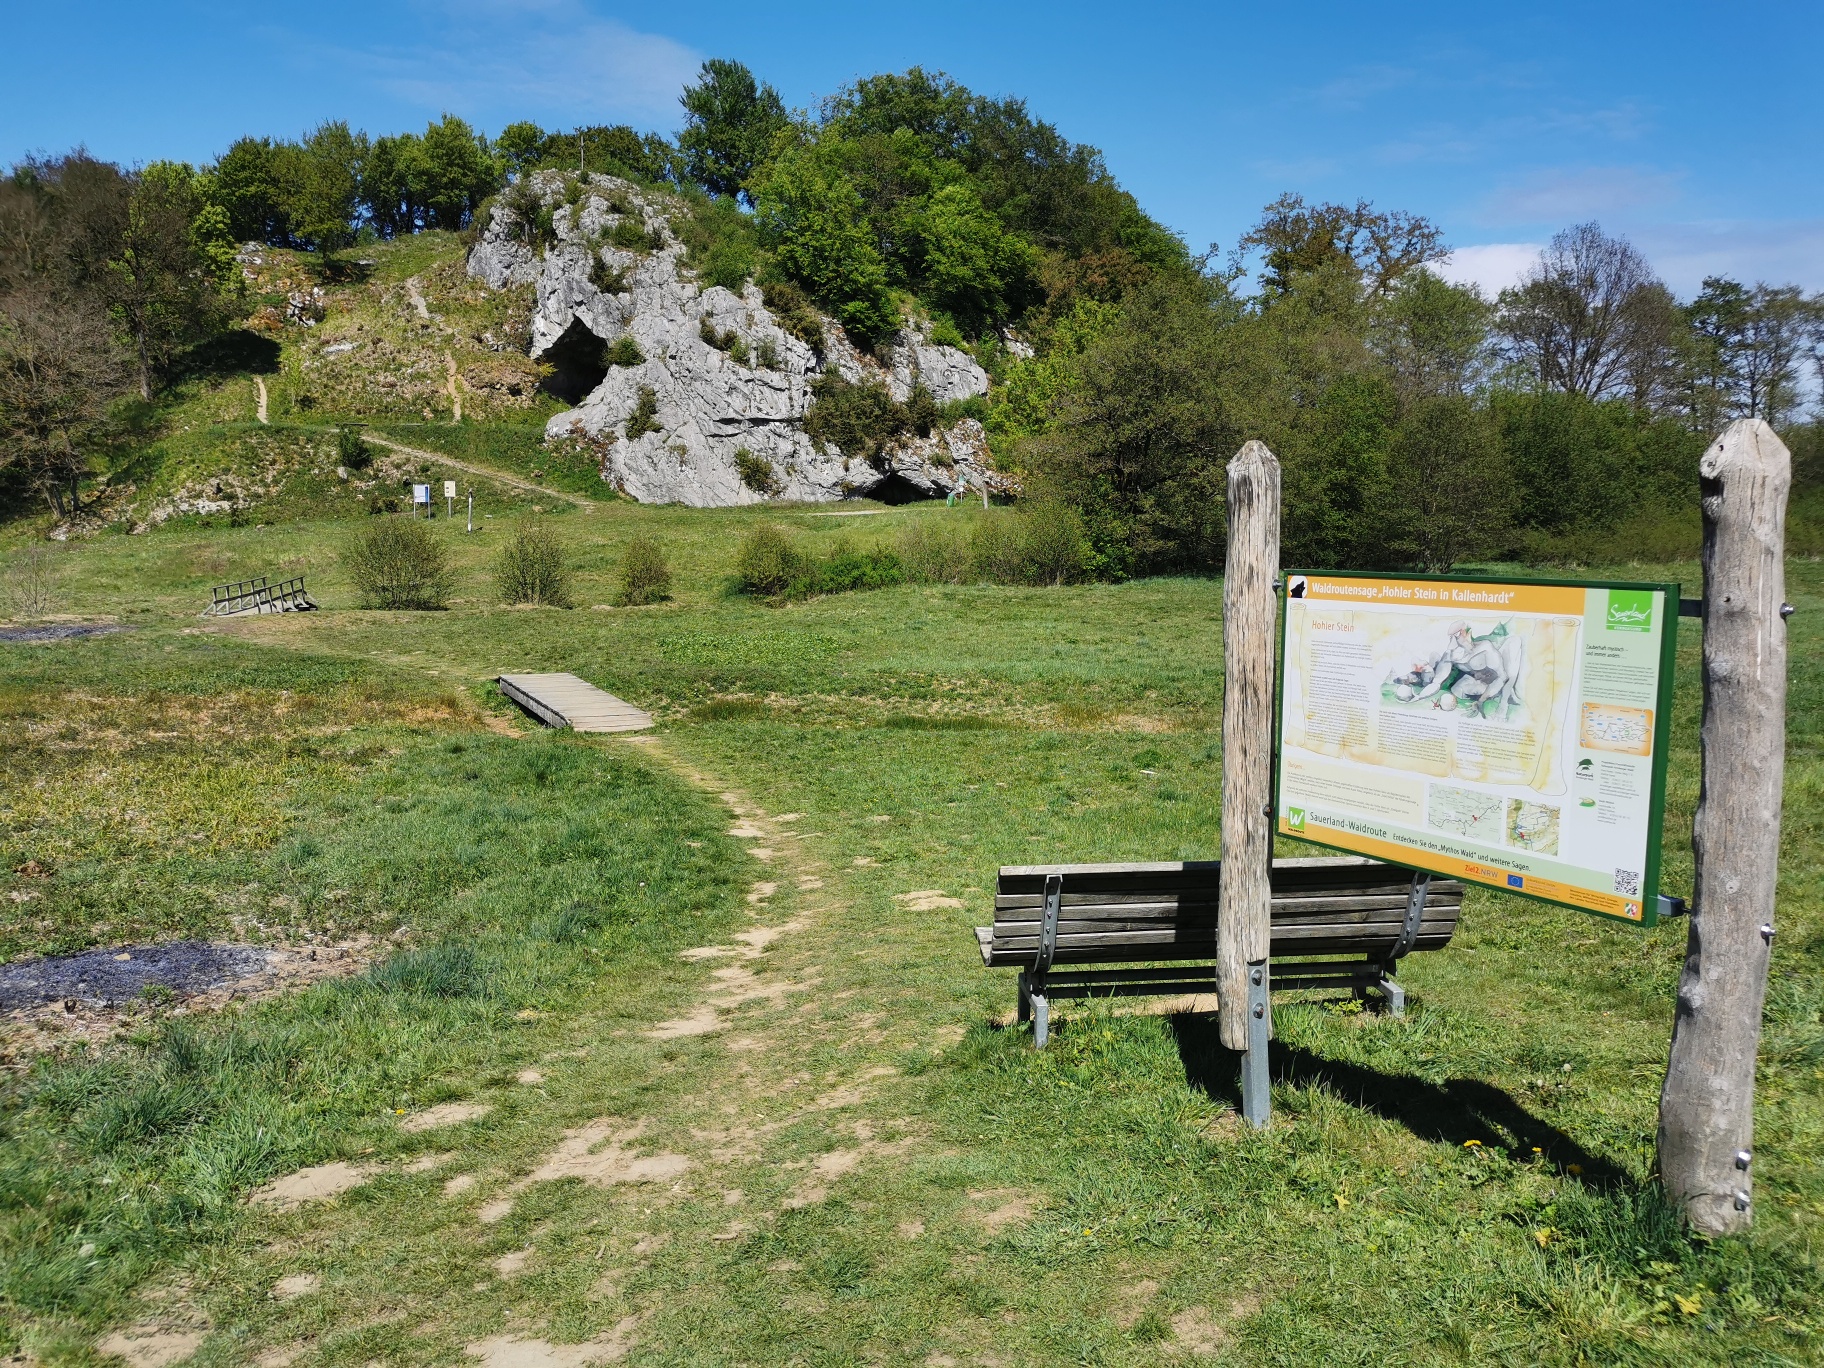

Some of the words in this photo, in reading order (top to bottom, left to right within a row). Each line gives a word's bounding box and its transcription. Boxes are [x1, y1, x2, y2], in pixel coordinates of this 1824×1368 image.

[1312, 582, 1377, 599] Waldroutensage
[1378, 586, 1412, 598] „Hohler
[1414, 588, 1437, 600] Stein
[1440, 589, 1448, 600] in
[1452, 589, 1514, 604] Kallenhardt“
[1312, 620, 1335, 631] Hohler
[1336, 622, 1355, 632] Stein
[1289, 810, 1304, 826] W
[1309, 811, 1387, 838] Sauerland-Waldroute
[1392, 833, 1418, 845] Entdecken
[1419, 839, 1427, 848] Sie
[1427, 841, 1438, 851] den
[1438, 843, 1460, 855] „Mythos
[1477, 853, 1489, 862] und
[1489, 856, 1511, 868] weitere
[1511, 860, 1531, 872] Sagen.
